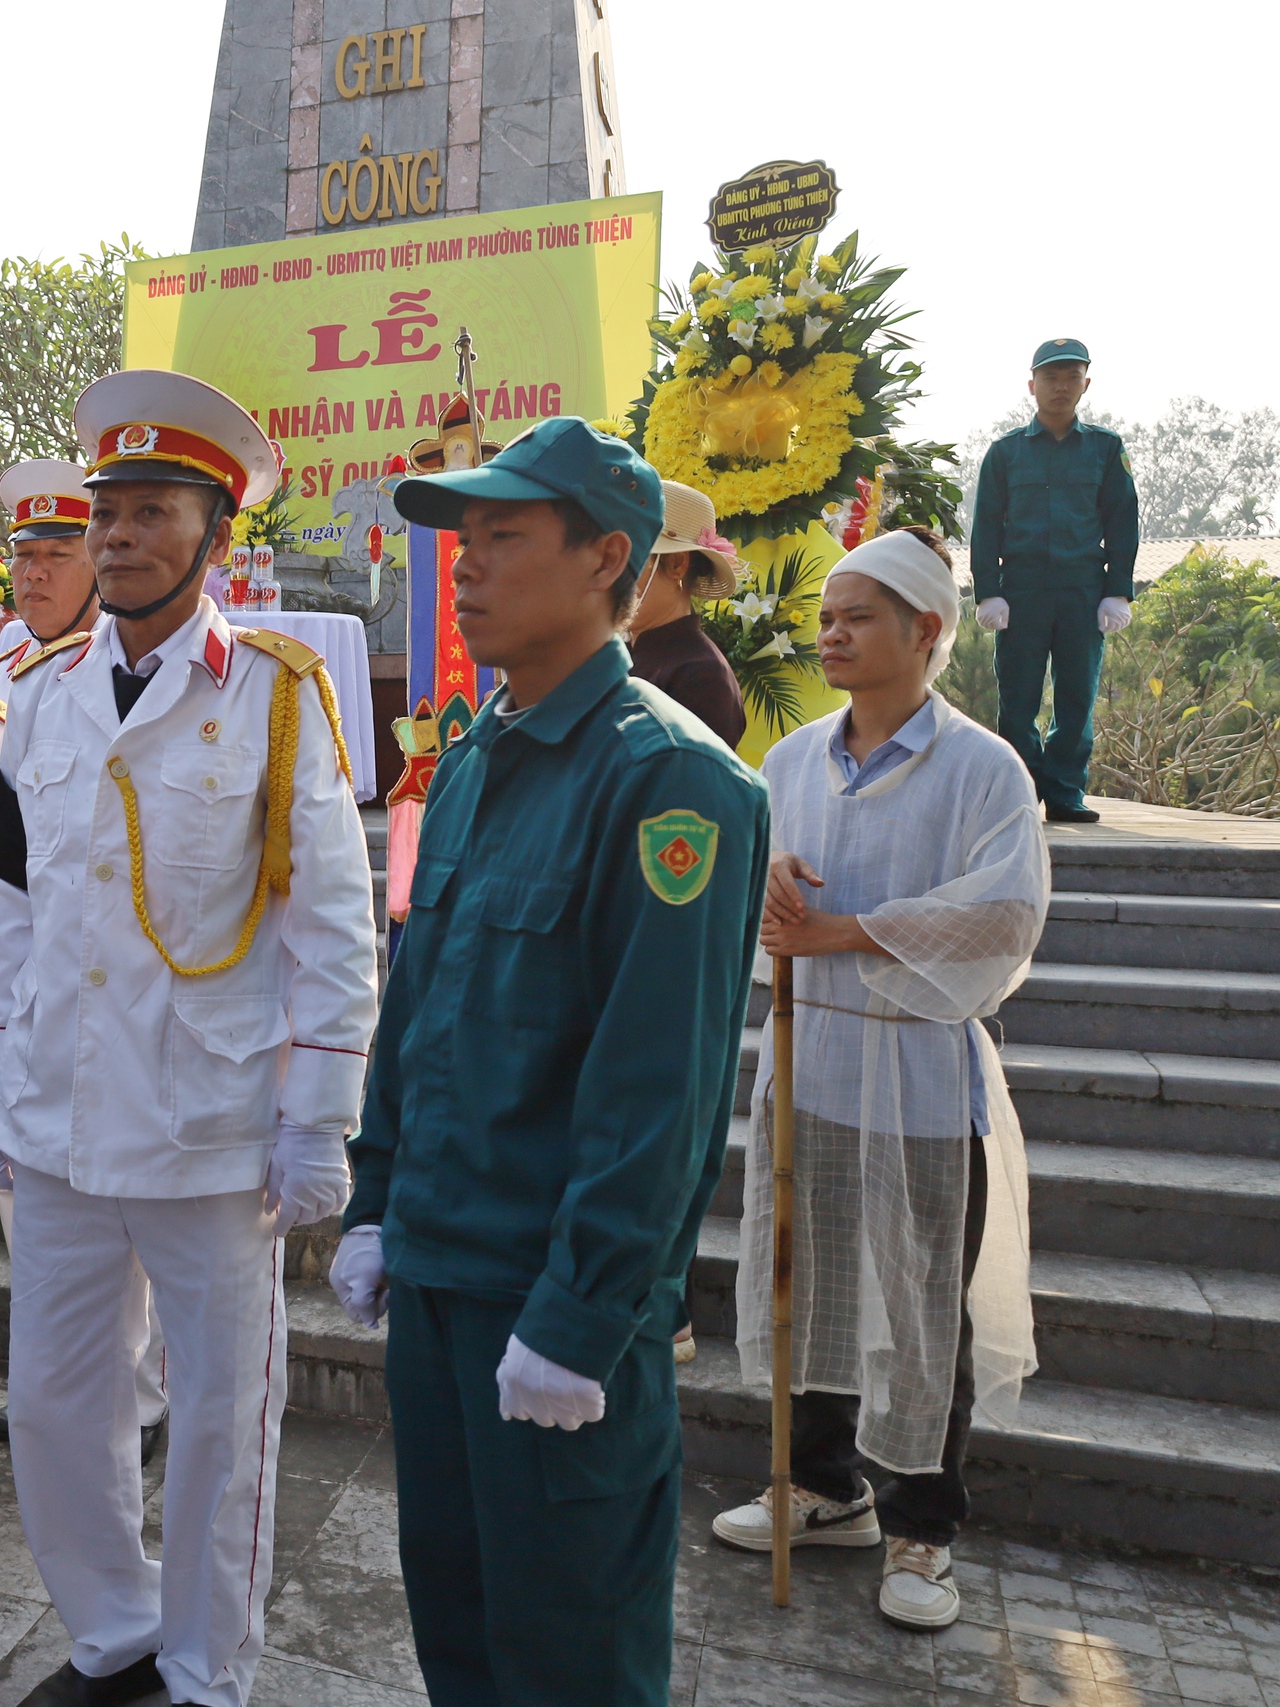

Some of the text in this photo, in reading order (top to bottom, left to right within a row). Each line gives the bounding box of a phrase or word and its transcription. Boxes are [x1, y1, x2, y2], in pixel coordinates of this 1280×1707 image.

[335, 25, 426, 100] GHI
[321, 132, 442, 225] CÔNG
[767, 179, 790, 196] HĐND
[797, 172, 819, 189] UBND
[717, 209, 749, 227] UBMTTQ
[148, 269, 186, 299] ĐẢNG
[189, 264, 207, 294] UỶ
[220, 264, 259, 290] HĐND
[272, 257, 312, 283] UBND
[326, 247, 386, 277] UBMTTQ
[390, 239, 423, 271] VIỆT
[426, 237, 463, 264] NAM
[467, 226, 532, 259] PHƯỜNG
[537, 221, 580, 251] TÙNG
[584, 213, 632, 247] THIỆN
[307, 288, 442, 372] LỄ
[268, 396, 355, 444] NHẬN
[365, 390, 405, 432] VÀ
[473, 379, 561, 422] TÁNG
[300, 457, 335, 499] SỸ
[301, 522, 347, 544] ngày
